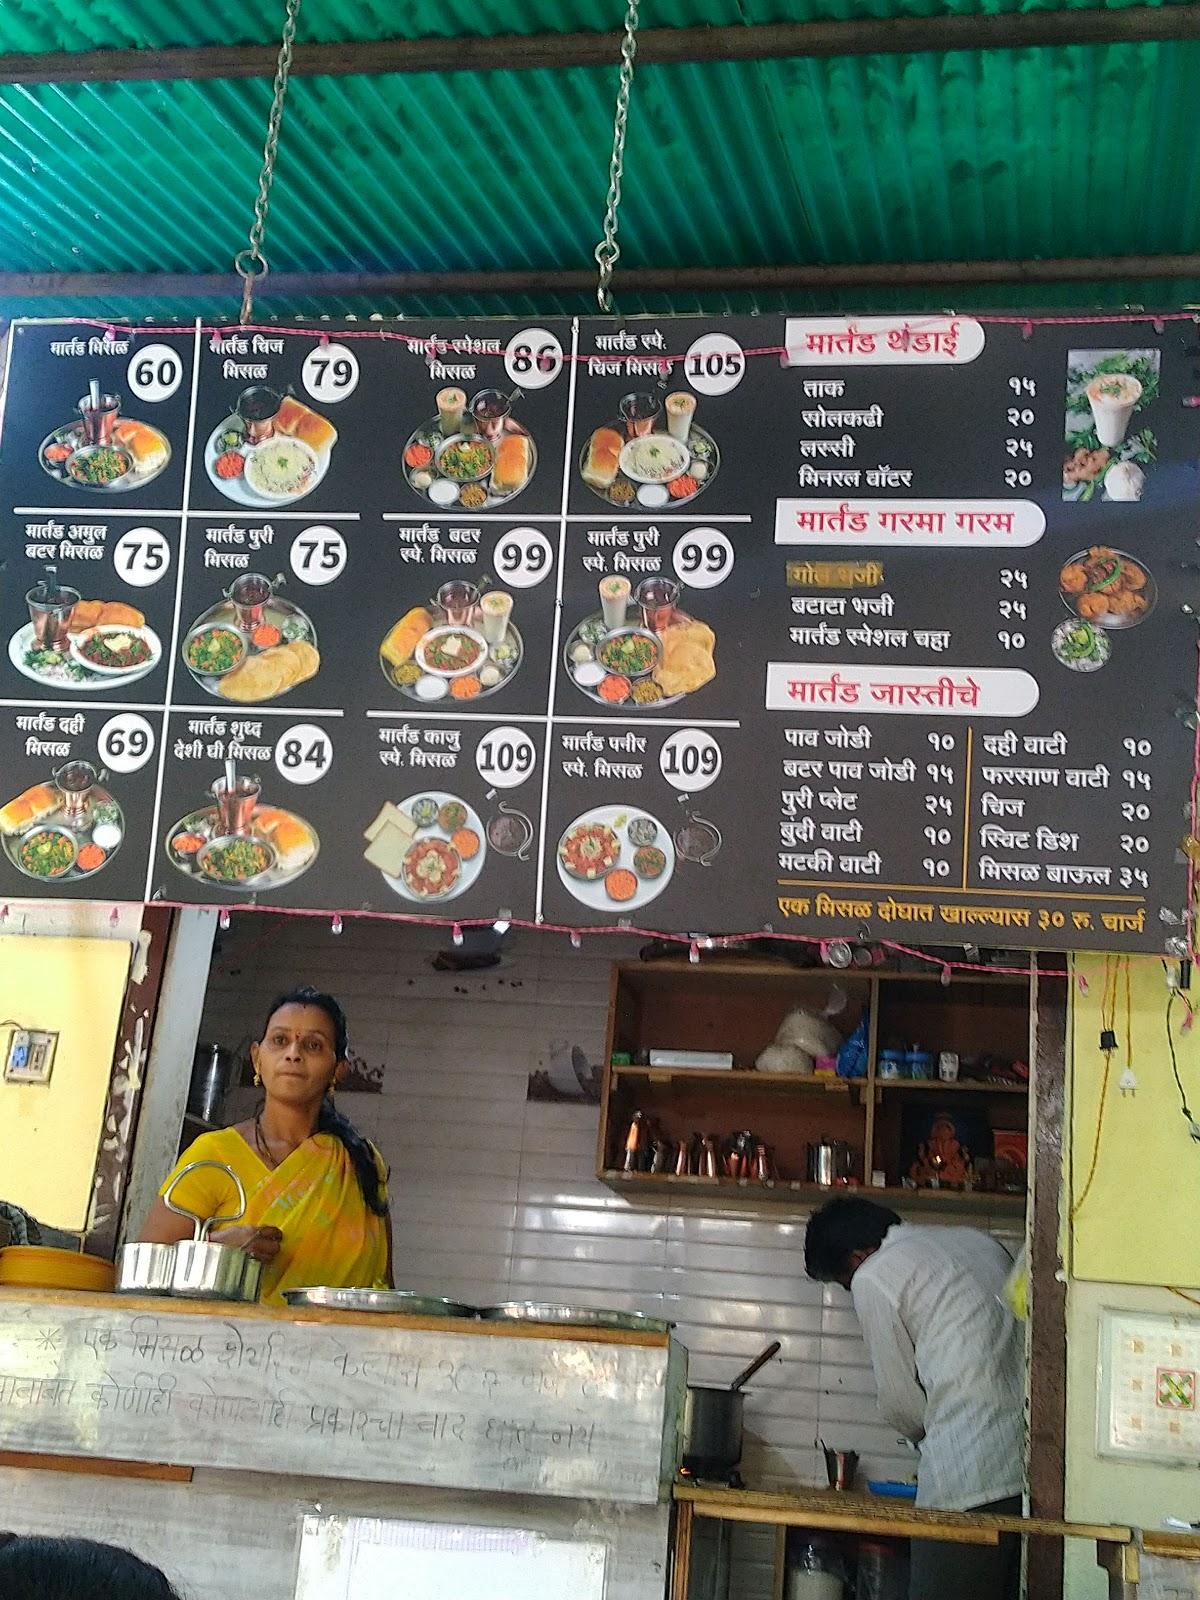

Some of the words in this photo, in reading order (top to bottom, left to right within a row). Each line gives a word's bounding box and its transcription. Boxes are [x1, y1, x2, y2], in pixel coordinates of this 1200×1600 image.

[252, 335, 284, 355] चिज
[806, 324, 878, 354] मार्तंड
[223, 359, 268, 379] मिसळ
[429, 360, 477, 380] मिसळ
[512, 345, 557, 372] 86
[689, 352, 742, 377] 105
[135, 359, 176, 386] 60
[310, 359, 353, 387] 79
[803, 380, 845, 398] ताक
[1008, 375, 1037, 397] १५
[1007, 407, 1035, 426] २०
[800, 434, 856, 458] लस्सी
[1006, 437, 1034, 458] २५
[798, 463, 861, 487] मिनरल
[865, 464, 913, 487] वॉटर
[1005, 468, 1032, 487] २०
[795, 502, 870, 533] मार्तंड
[877, 510, 946, 534] गरमा
[955, 511, 1015, 534] गरम
[25, 520, 65, 539] मार्तंड
[68, 525, 108, 545] अमुल
[205, 523, 246, 544] मार्तंड
[248, 525, 274, 550] पुरी
[399, 523, 440, 543] मार्तंड
[449, 528, 481, 543] बटर
[587, 525, 630, 546] मार्तंड
[633, 526, 660, 552] पुरी
[25, 544, 57, 559] बटर
[59, 539, 104, 560] मिसळ
[121, 541, 164, 570] 75
[204, 548, 250, 568] मिसळ
[298, 540, 341, 569] 75
[400, 543, 425, 563] स्पे.
[430, 543, 477, 564] मिसळ
[500, 543, 544, 572] 99
[582, 551, 608, 572] स्पे.
[613, 551, 662, 572] मिसळ
[680, 543, 728, 572] 99
[1000, 568, 1028, 590] २५
[791, 597, 847, 615] बटाटा
[851, 592, 895, 616] भजी
[999, 599, 1027, 620] २५
[789, 621, 841, 646] मार्तंड
[846, 623, 909, 648] स्पेशल
[914, 629, 950, 652] चहा
[998, 630, 1026, 649] १०
[787, 673, 861, 703] मार्तंड
[870, 675, 981, 707] जास्तीचे
[16, 712, 56, 733] मार्तंड
[58, 712, 85, 735] दही
[188, 715, 227, 736] मार्तंड
[25, 736, 72, 758] मिसळ
[105, 729, 149, 757] 69
[174, 738, 204, 760] देशी
[206, 740, 225, 760] घी
[228, 740, 272, 761] मिसळ
[378, 724, 421, 745] मार्तंड
[424, 729, 461, 752] काजु
[562, 731, 604, 753] मार्तंड
[607, 732, 647, 754] पनीर
[784, 729, 819, 749] पाव
[824, 724, 872, 751] जोडी
[928, 731, 955, 751] १०
[983, 730, 1018, 758] दही
[1024, 730, 1067, 757] वाटी
[1123, 737, 1152, 757] १०
[281, 738, 327, 769] 84
[379, 746, 404, 767] स्पे.
[409, 746, 458, 768] मिसळ
[480, 743, 532, 771] 109
[664, 745, 718, 775] 109
[562, 757, 589, 778] स्पे.
[594, 757, 643, 780] मिसळ
[783, 759, 823, 779] बटर
[829, 761, 863, 781] पाव
[868, 757, 917, 783] जोडी
[926, 764, 955, 784] १५
[983, 765, 1059, 787] फरसाण
[1066, 763, 1110, 789] वाटी
[1122, 770, 1152, 791] १५
[781, 785, 814, 816] पुरी
[818, 786, 858, 811] प्लेट
[925, 794, 952, 816] २५
[980, 791, 1026, 817] चिज
[1121, 801, 1151, 822] २०
[780, 815, 816, 847] बुंदी
[820, 818, 863, 842] वाटी
[924, 825, 951, 845] १०
[1036, 825, 1080, 852] डिश
[1120, 834, 1150, 854] २०
[778, 848, 834, 872] मटकी
[839, 850, 882, 875] वाटी
[922, 857, 950, 877] १०
[979, 855, 1041, 882] मिसळ
[1119, 866, 1149, 889] ३५
[777, 897, 811, 918] एक
[815, 891, 873, 919] मिसळ
[877, 895, 934, 923] दोघात
[1038, 909, 1065, 931] ३०
[1100, 908, 1146, 934] चार्ज
